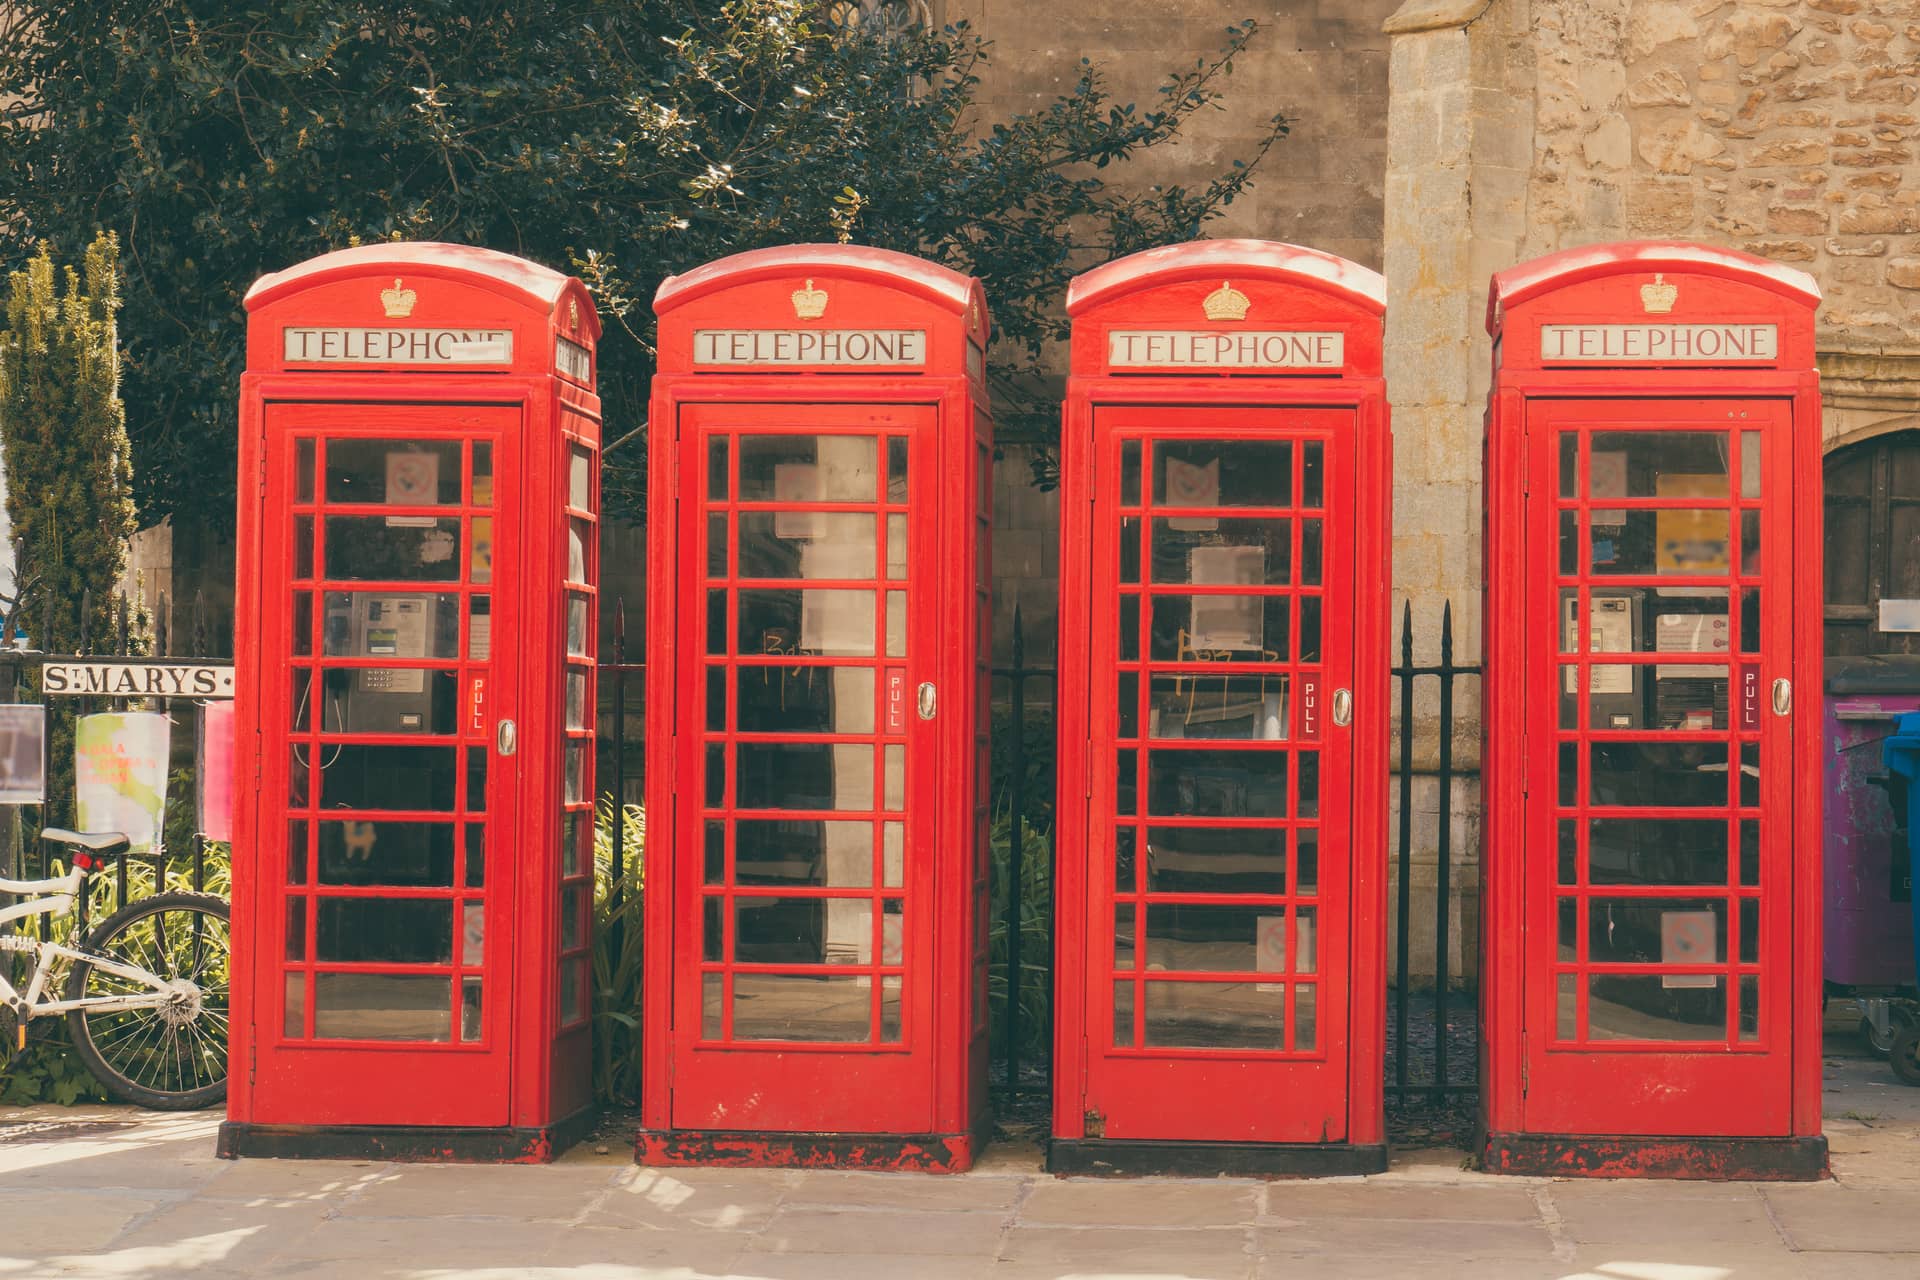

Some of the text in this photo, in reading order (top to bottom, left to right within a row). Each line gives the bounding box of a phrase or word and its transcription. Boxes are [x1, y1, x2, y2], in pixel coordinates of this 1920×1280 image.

[703, 333, 915, 361] TELEPHONE
[1120, 335, 1333, 363] TELEPHONE
[1551, 328, 1767, 356] TELEPHONE
[474, 679, 483, 729] PULL
[891, 677, 900, 727] PULL
[1305, 683, 1314, 733] PULL
[1746, 673, 1755, 723] PULL
